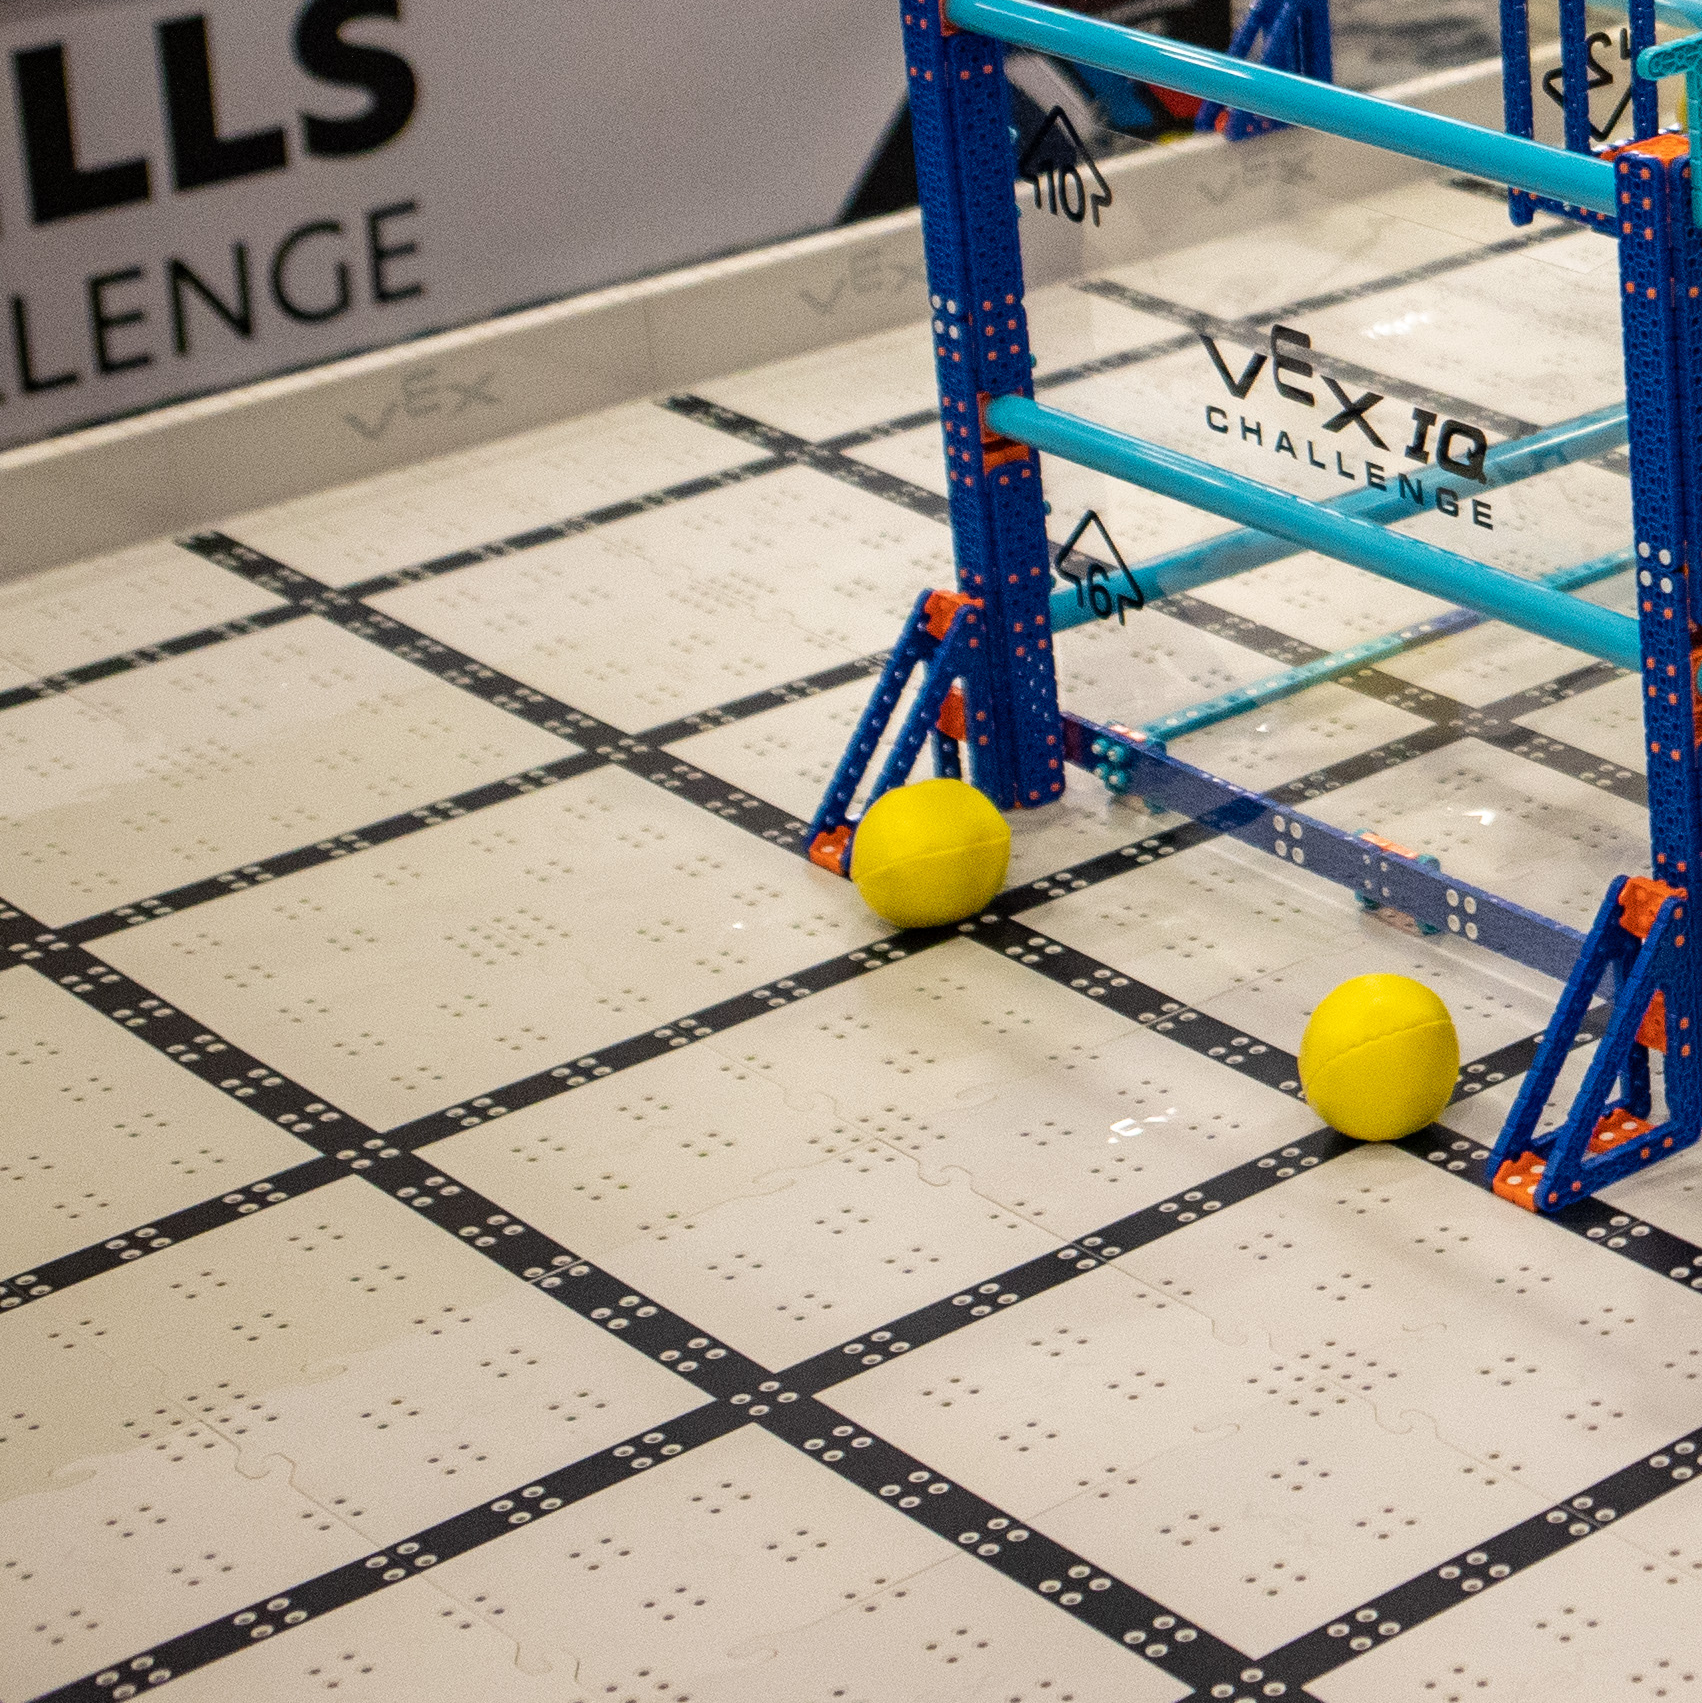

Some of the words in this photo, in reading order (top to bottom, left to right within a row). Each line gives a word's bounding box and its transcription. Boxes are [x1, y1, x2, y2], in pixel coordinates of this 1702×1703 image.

[343, 367, 502, 441] VEX
[1200, 323, 1392, 453] VEX
[1404, 406, 1489, 486] IQ
[1205, 404, 1495, 531] CHALLENGE
[1087, 562, 1113, 620] 6
